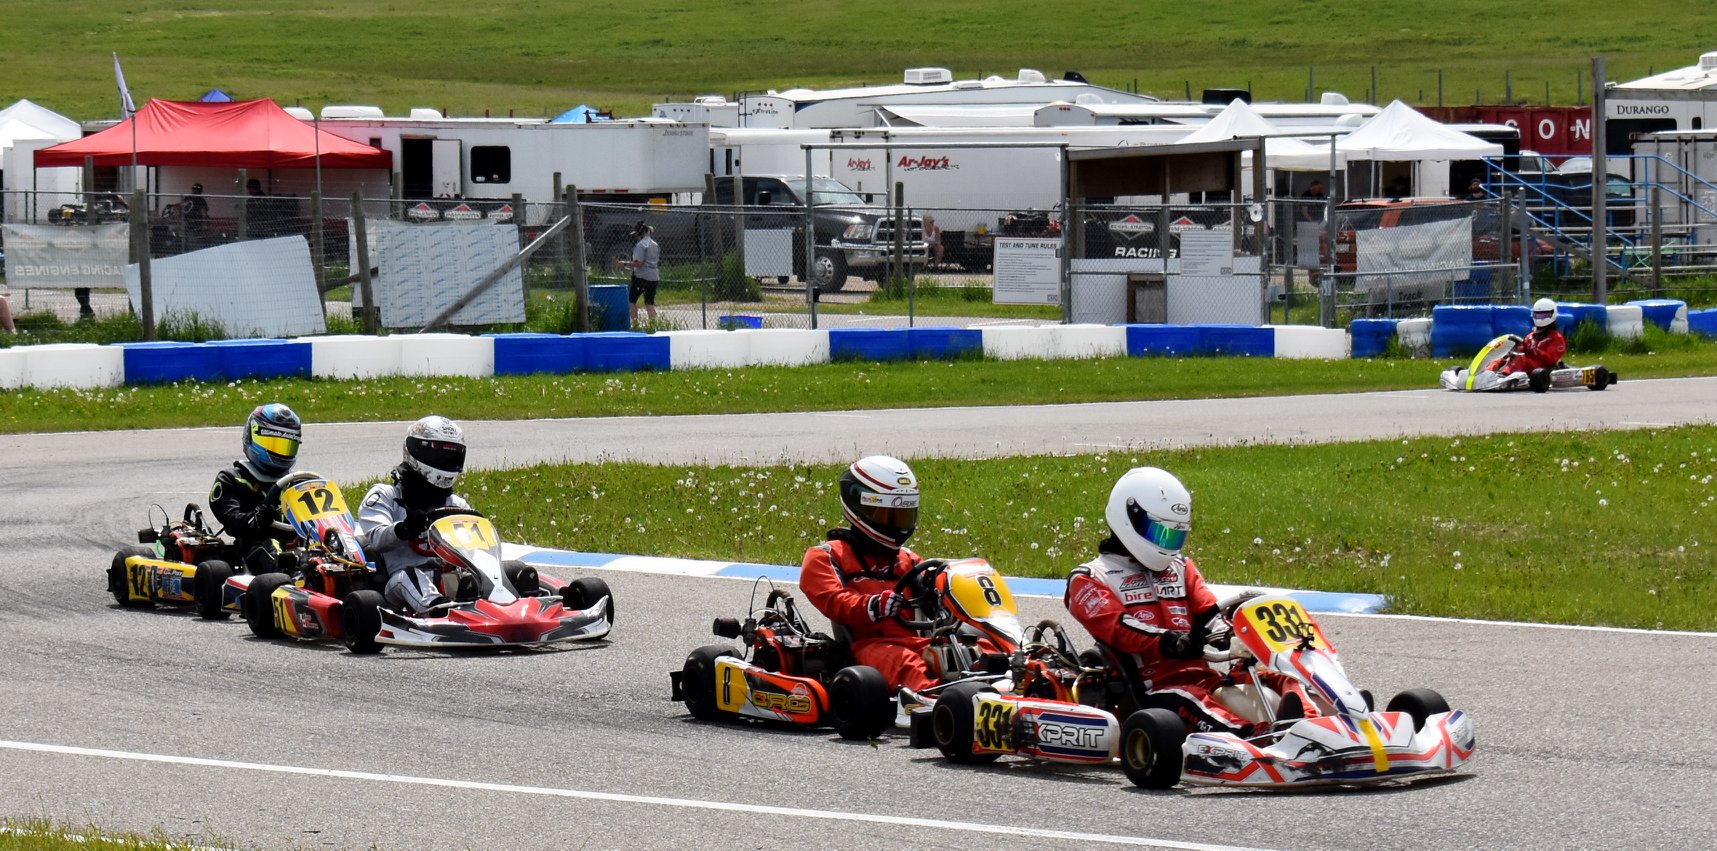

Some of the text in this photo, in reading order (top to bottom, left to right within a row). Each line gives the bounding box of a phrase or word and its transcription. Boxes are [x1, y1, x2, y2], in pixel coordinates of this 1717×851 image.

[897, 155, 950, 168] Ar-Jay's
[297, 488, 340, 516] 12
[976, 575, 1003, 607] 8
[976, 702, 1013, 750] 331
